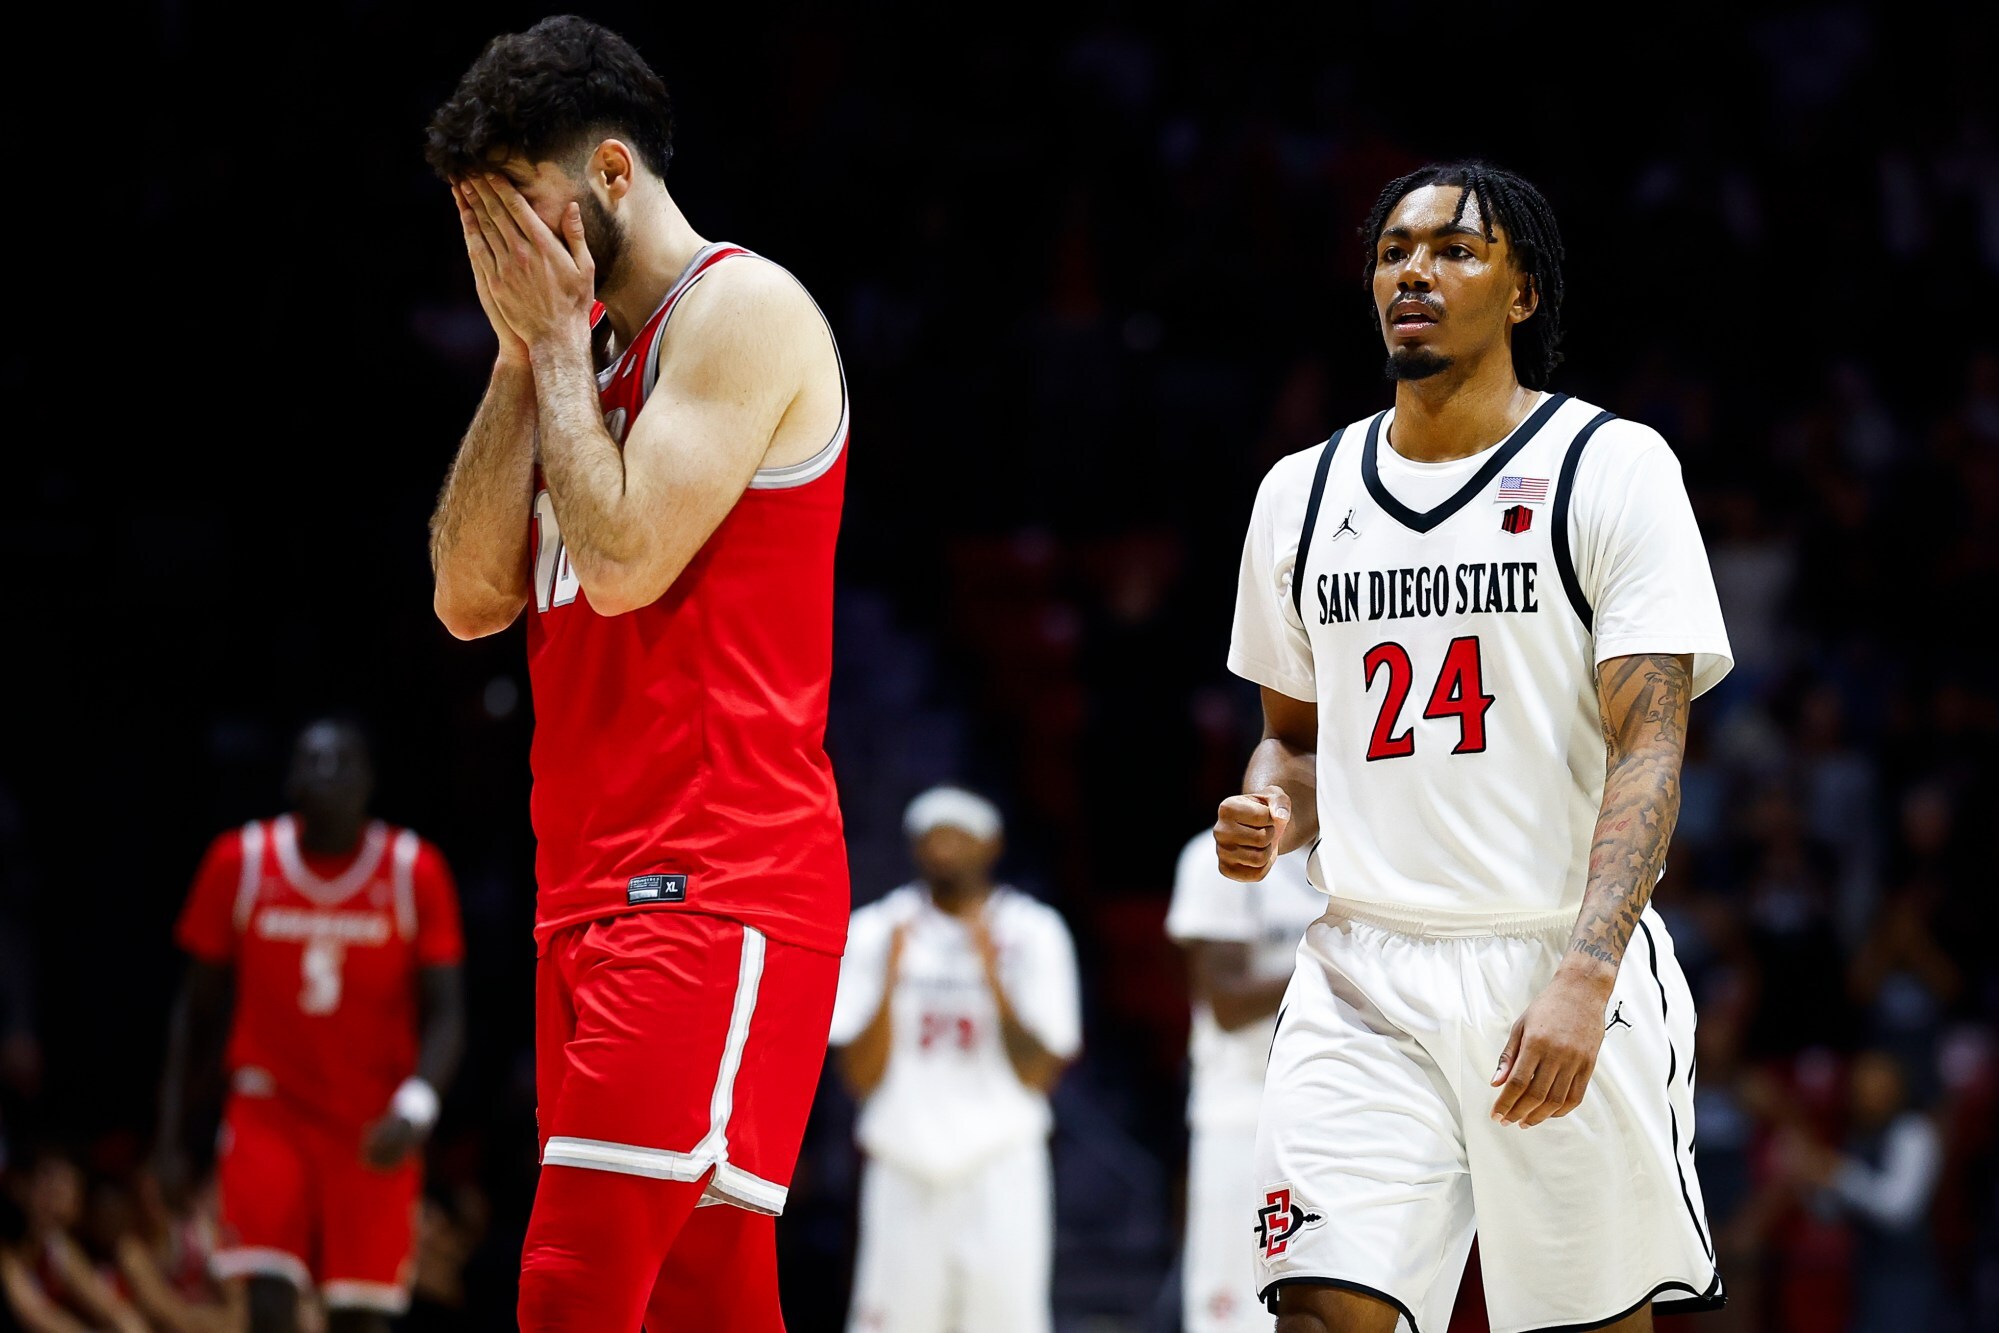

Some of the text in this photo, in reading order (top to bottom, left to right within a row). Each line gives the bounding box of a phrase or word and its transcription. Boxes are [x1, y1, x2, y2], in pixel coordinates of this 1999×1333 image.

[534, 489, 581, 613] 1
[1317, 562, 1538, 625] SAN DIEGO STATE
[1363, 636, 1496, 762] 24
[665, 881, 678, 893] XL
